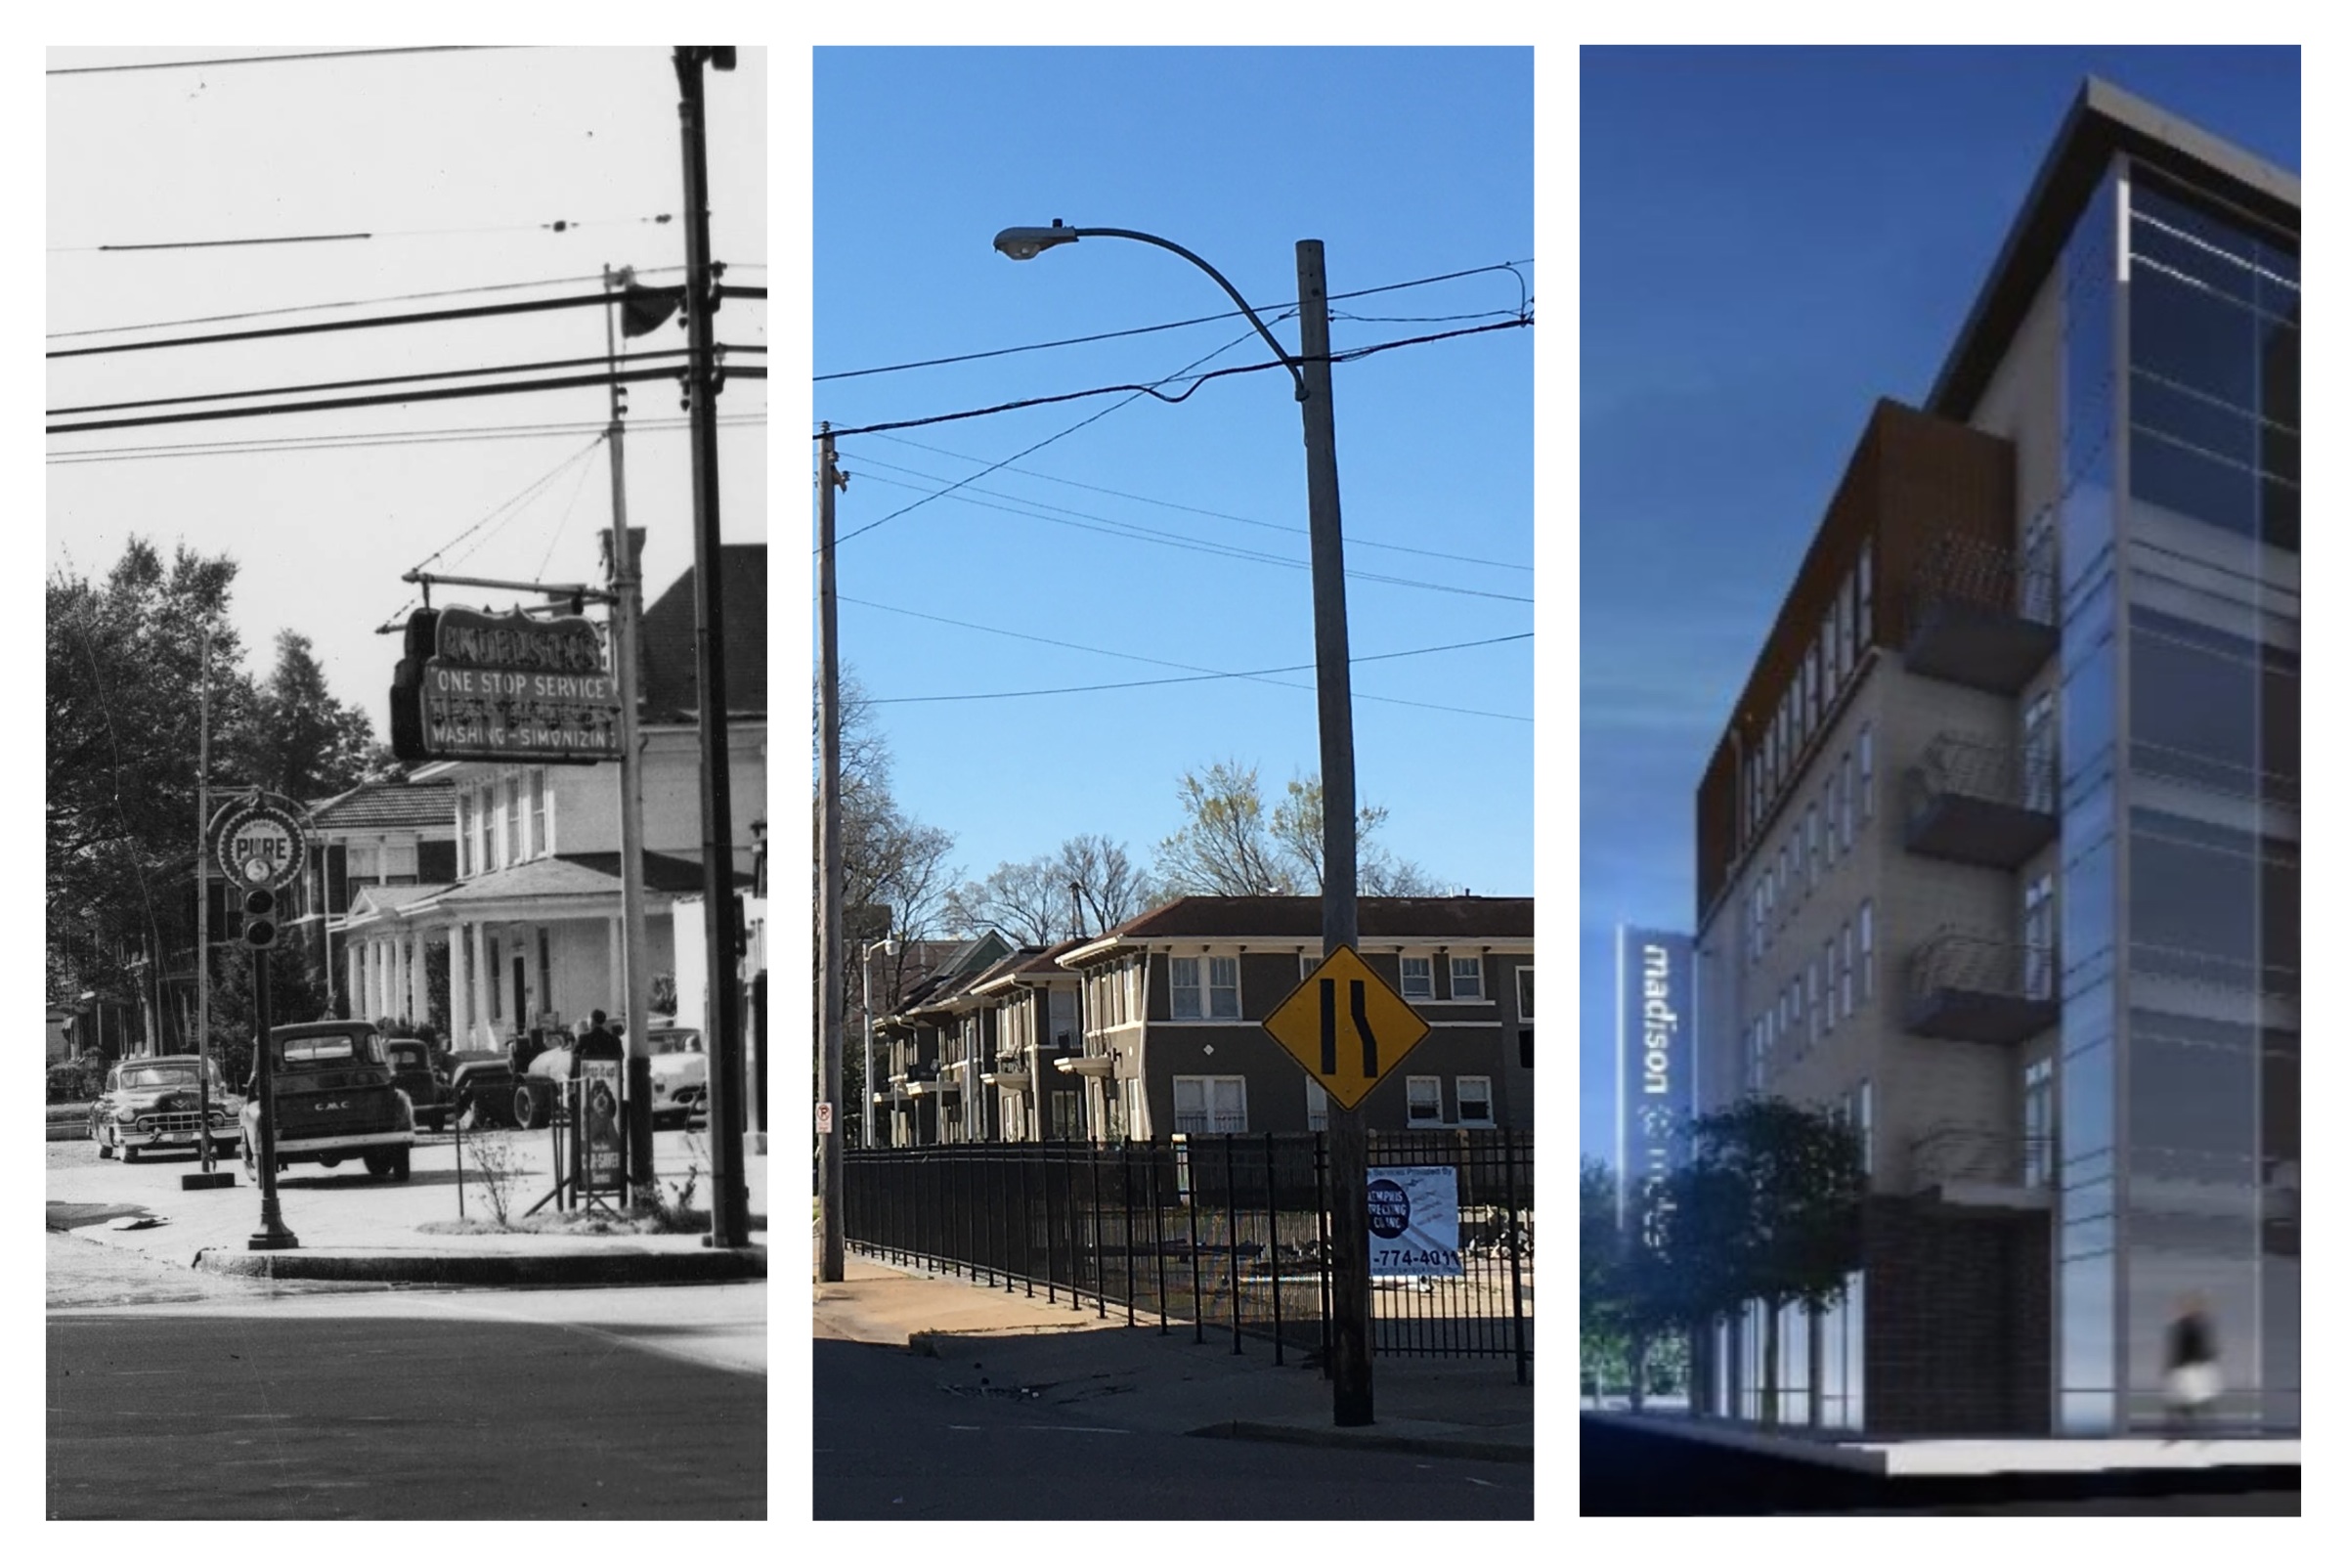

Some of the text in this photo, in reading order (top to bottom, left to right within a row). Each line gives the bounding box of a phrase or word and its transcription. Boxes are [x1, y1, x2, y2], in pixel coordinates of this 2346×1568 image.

[481, 672, 527, 695] STOP
[236, 838, 287, 860] PURE
[1642, 944, 1677, 1094] madison
